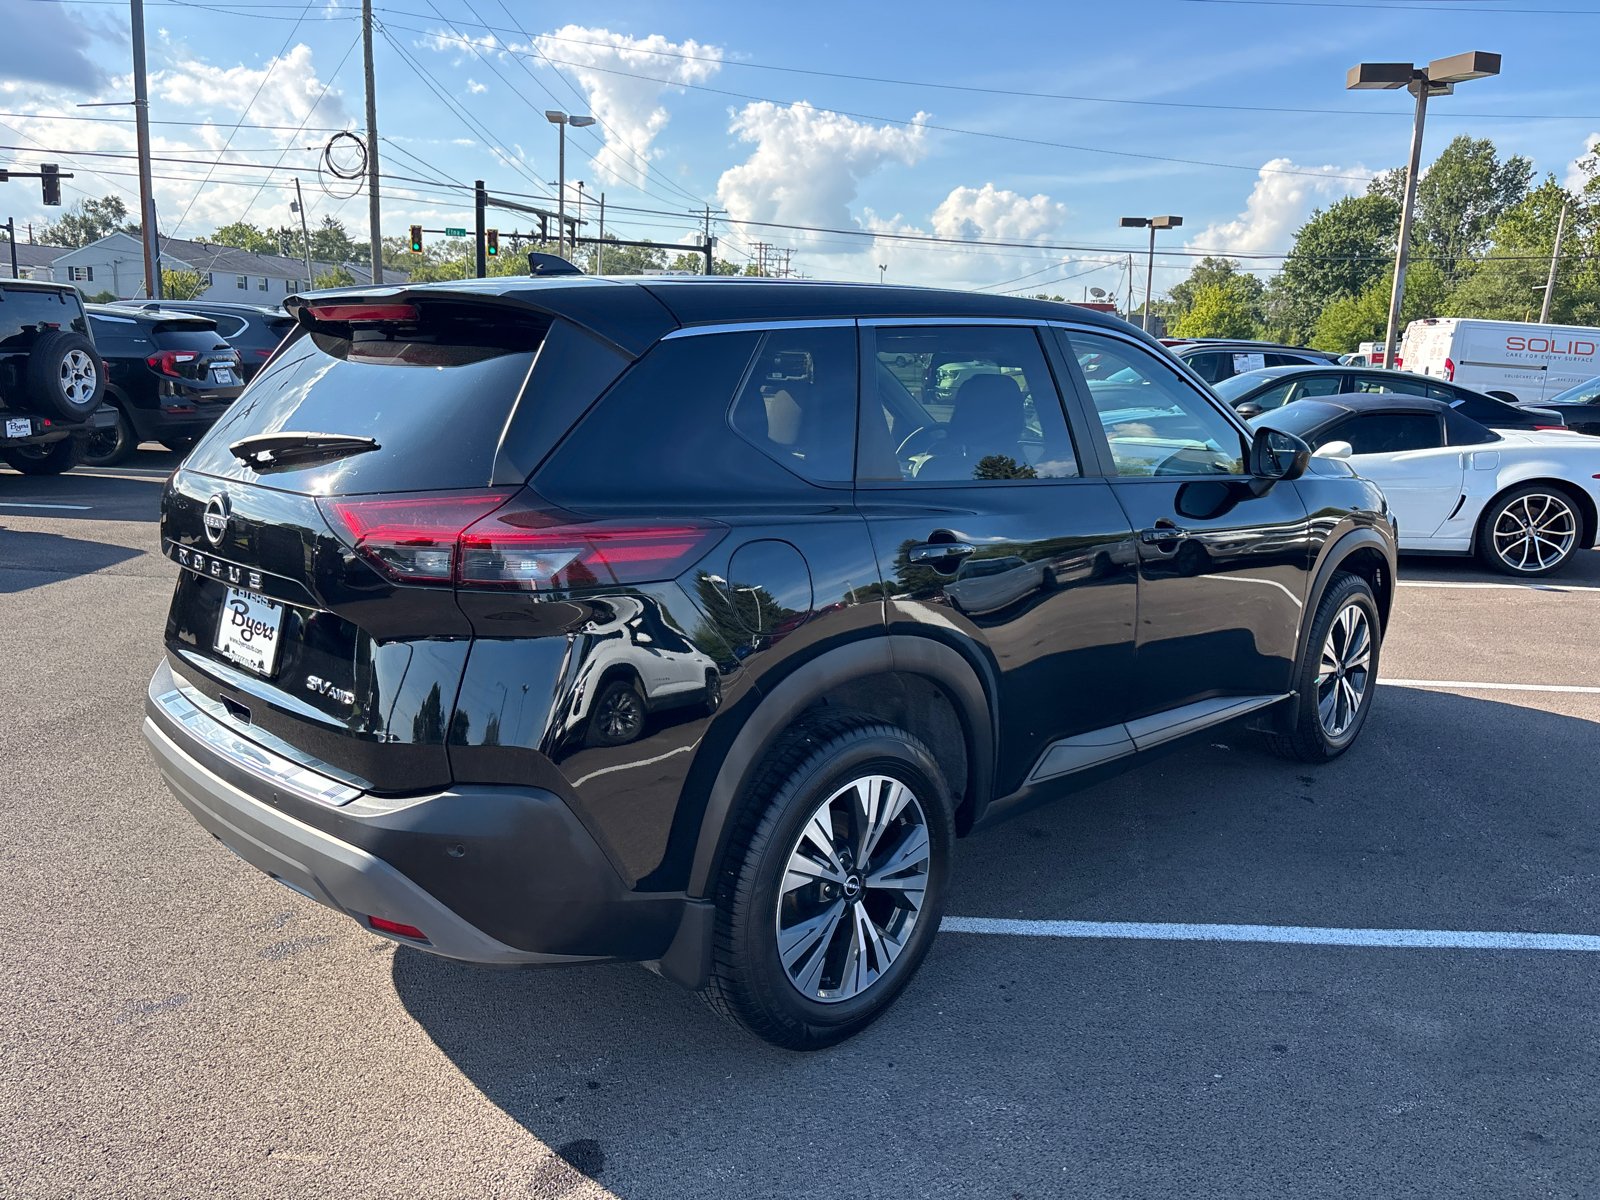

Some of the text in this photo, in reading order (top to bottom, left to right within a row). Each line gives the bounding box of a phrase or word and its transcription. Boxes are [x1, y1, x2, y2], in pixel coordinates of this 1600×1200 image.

[1506, 337, 1595, 356] SOLID
[178, 548, 264, 590] ROGUE
[230, 599, 275, 642] Byers
[306, 675, 355, 705] SV AWD
